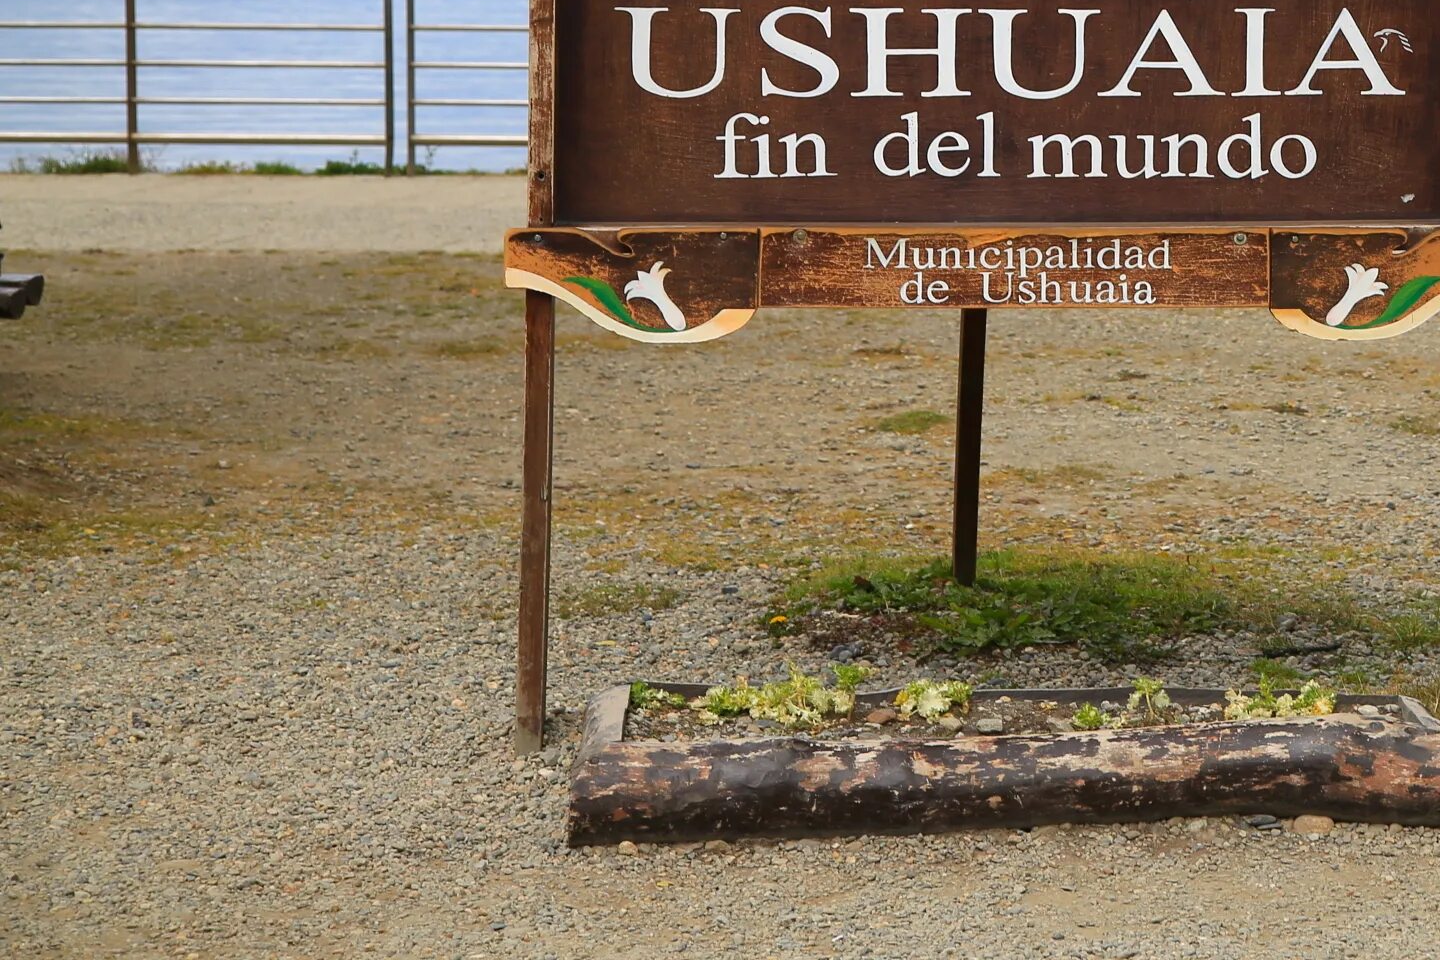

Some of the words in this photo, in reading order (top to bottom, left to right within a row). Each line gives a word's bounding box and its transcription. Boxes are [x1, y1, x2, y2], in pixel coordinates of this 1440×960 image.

[614, 5, 1406, 100] USHUAIA
[713, 111, 838, 179] fin
[873, 111, 1001, 178] del
[1026, 111, 1317, 180] mundo
[862, 237, 1173, 279] Municipalidad
[899, 271, 950, 305] de
[977, 270, 1157, 306] Ushuaia
